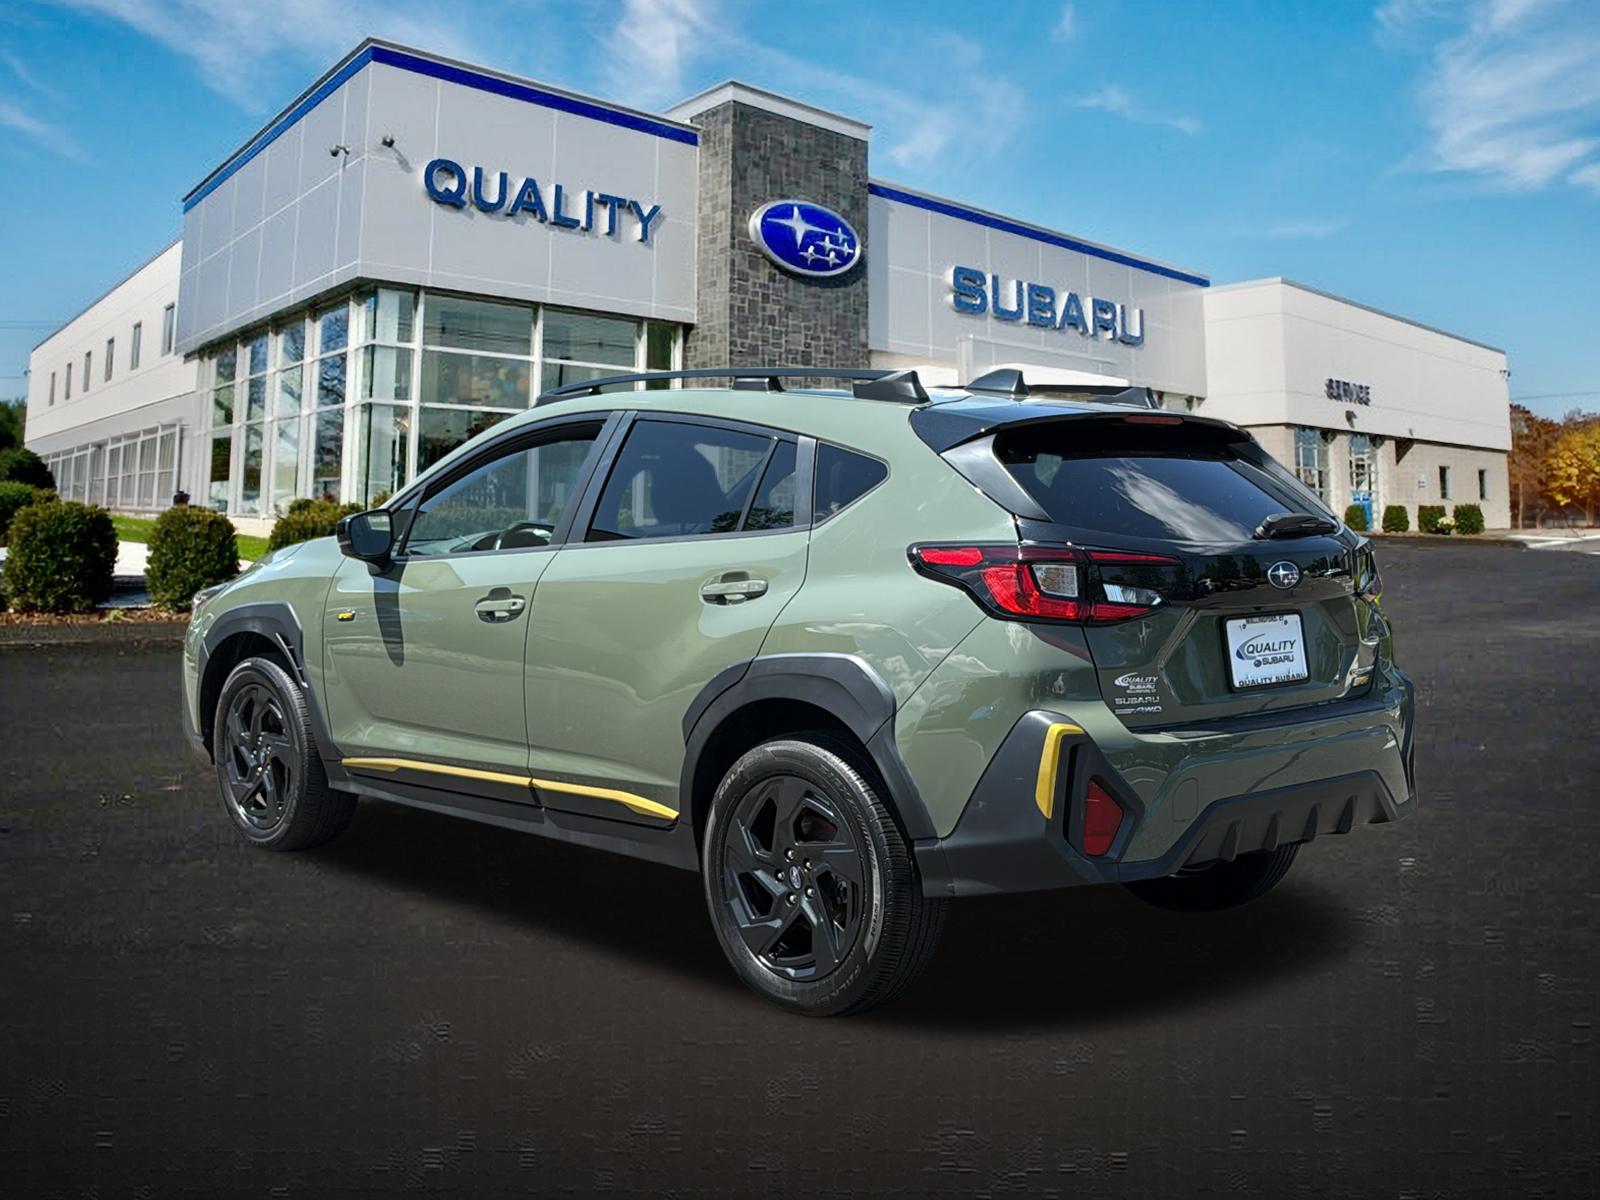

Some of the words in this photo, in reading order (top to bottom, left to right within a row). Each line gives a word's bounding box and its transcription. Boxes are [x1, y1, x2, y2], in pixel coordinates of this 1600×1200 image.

[424, 158, 661, 243] QUALITY
[951, 266, 1145, 347] SUBARU
[1246, 640, 1296, 655] QUALITY
[1261, 655, 1294, 666] SUBARU
[1239, 676, 1273, 687] QUALITY
[1275, 672, 1306, 682] SUBARU
[1115, 696, 1160, 704] SUBARU
